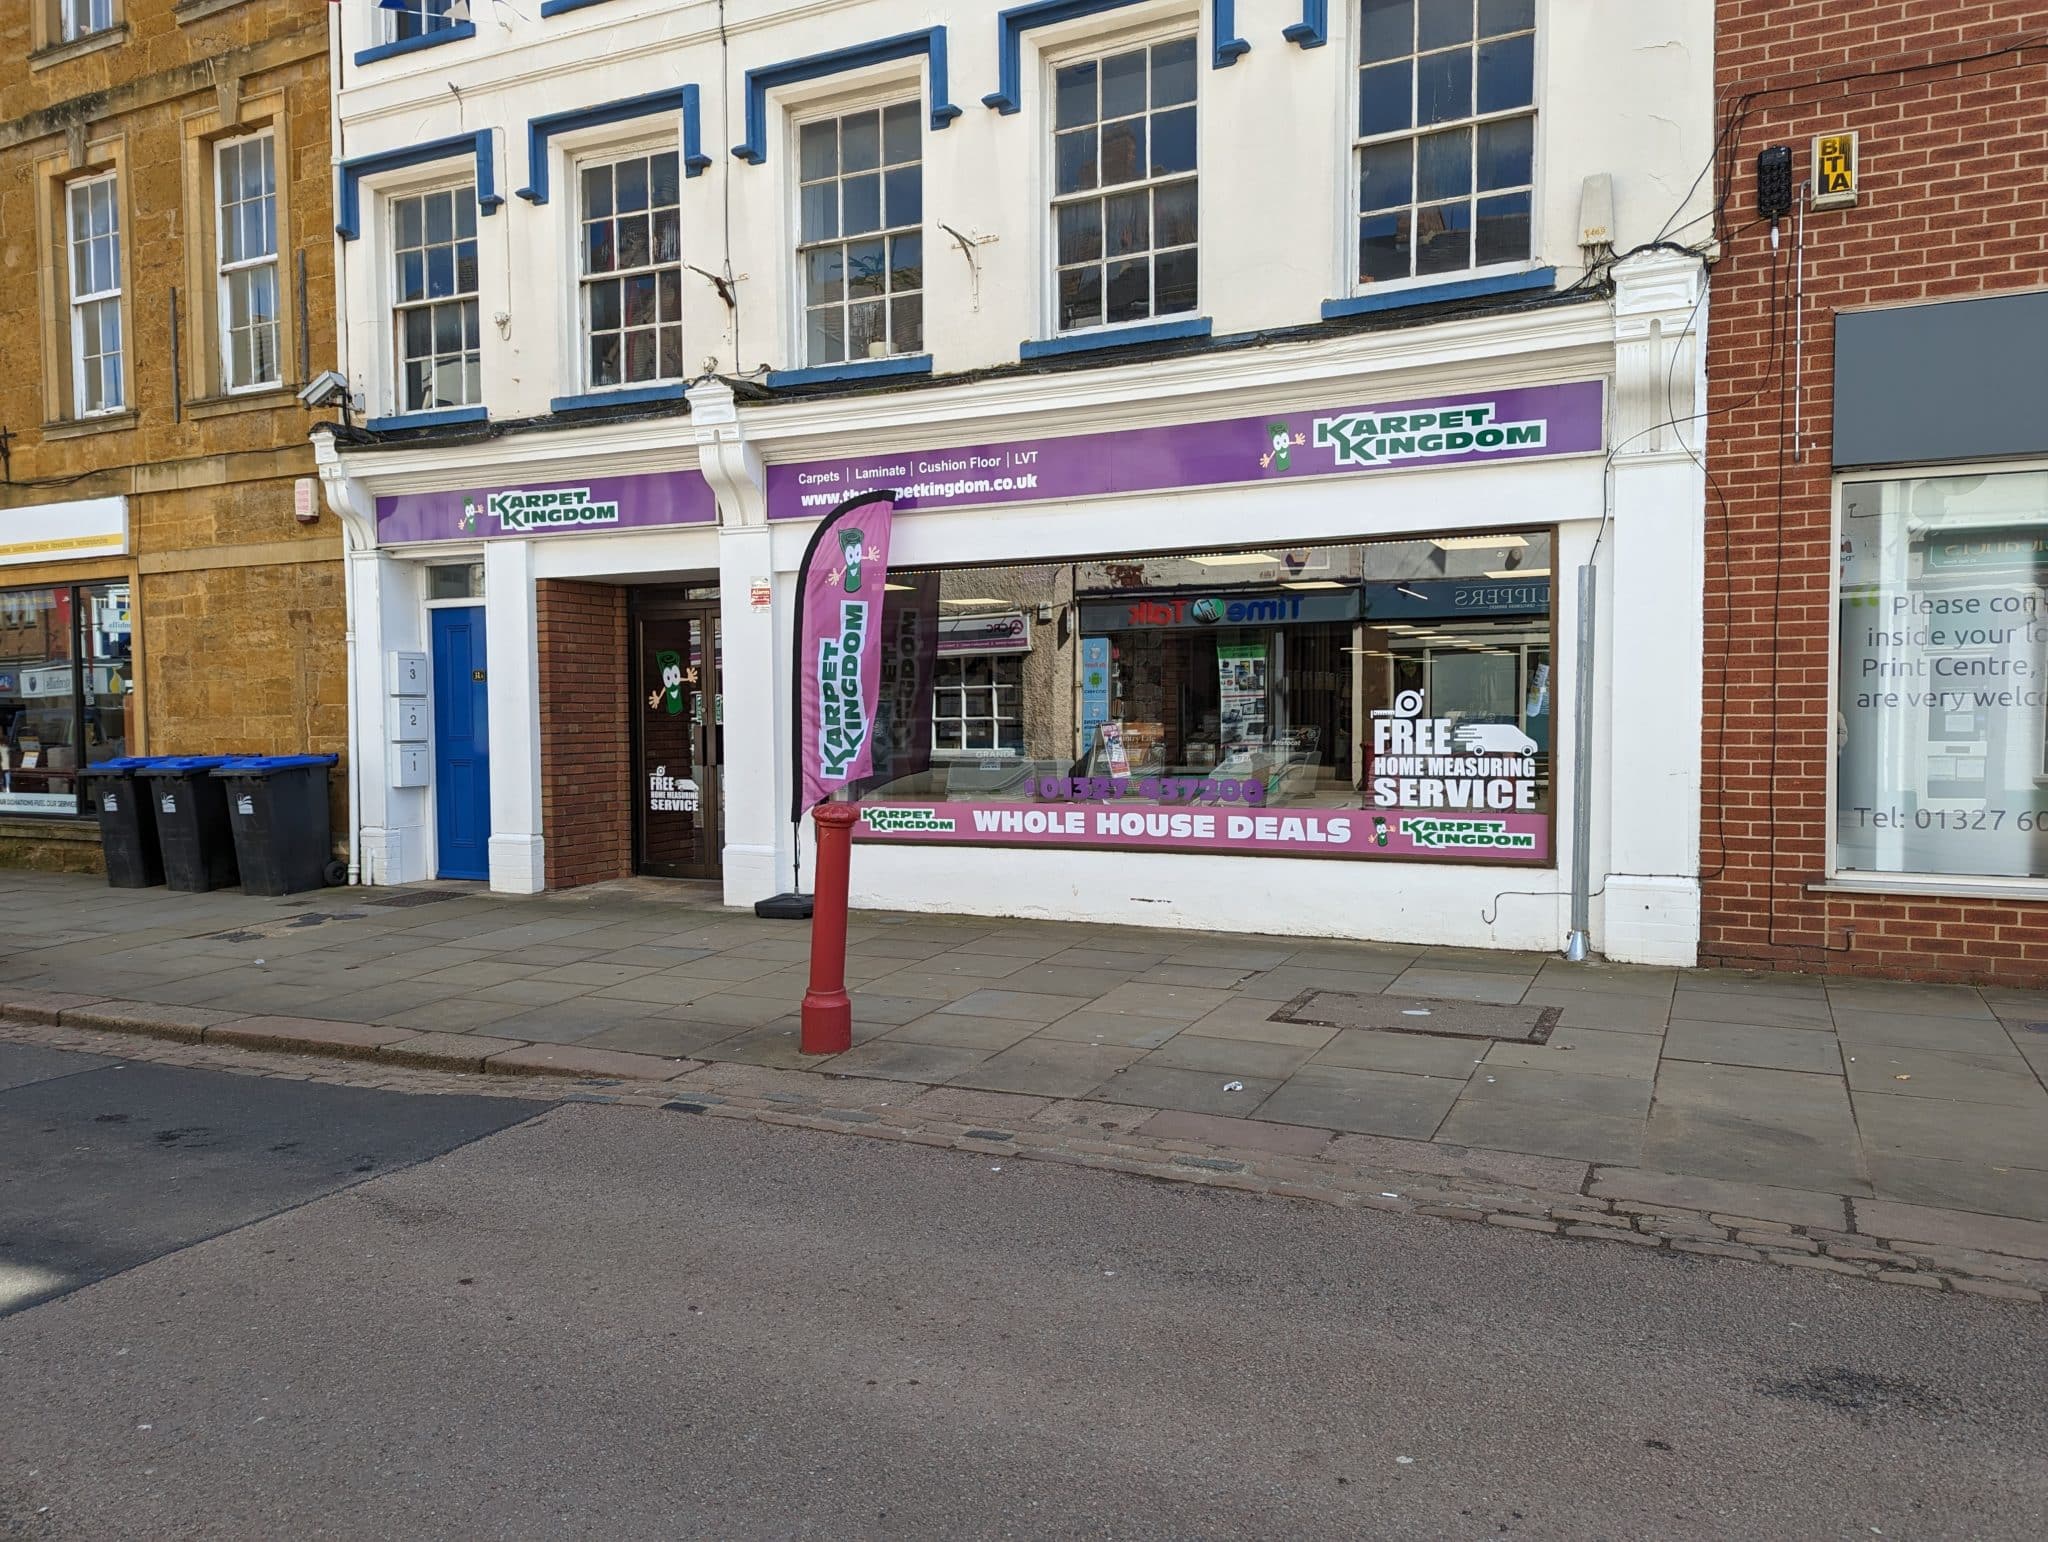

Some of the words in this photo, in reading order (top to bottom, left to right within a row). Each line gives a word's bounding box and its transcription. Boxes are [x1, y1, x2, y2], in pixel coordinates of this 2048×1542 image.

[1317, 408, 1490, 443] KARPET
[1340, 425, 1542, 461] KINGDOM
[798, 472, 840, 486] Carpets
[855, 464, 906, 480] Laminate
[918, 458, 967, 474] Cushion
[970, 456, 1001, 469] Floor
[1015, 452, 1039, 465] LVT
[801, 474, 1038, 507] www.thpetkingdom.co.uk
[490, 491, 588, 513] KARPET
[503, 505, 616, 528] KINGDOM
[1893, 594, 1981, 616] Please
[1868, 625, 1946, 647] inside
[1954, 627, 2017, 651] your
[410, 669, 416, 679] 3
[1862, 656, 1927, 678] Print
[1935, 656, 2037, 679] Centre,
[841, 604, 865, 759] KINGDOM
[822, 642, 845, 776] KARPET
[1857, 692, 1899, 708] are
[1907, 691, 1966, 711] very
[410, 714, 417, 726] 2
[1373, 718, 1451, 755] FREE
[412, 760, 416, 771] 1
[1373, 757, 1424, 776] HOME
[1428, 757, 1536, 777] MEASURING
[650, 776, 674, 791] FREE
[1373, 778, 1536, 809] SERVICE
[651, 799, 699, 811] SERVICE
[863, 809, 934, 820] KARPET
[871, 817, 954, 831] KINGDOM
[972, 810, 1085, 833] WHOLE
[1096, 812, 1215, 838] HOUSE
[1228, 815, 1352, 844] DEALS
[1402, 820, 1503, 833] KARPET
[1853, 806, 1905, 829] Tel:
[1914, 808, 2007, 831] 01327
[1415, 831, 1532, 846] KINGDOM
